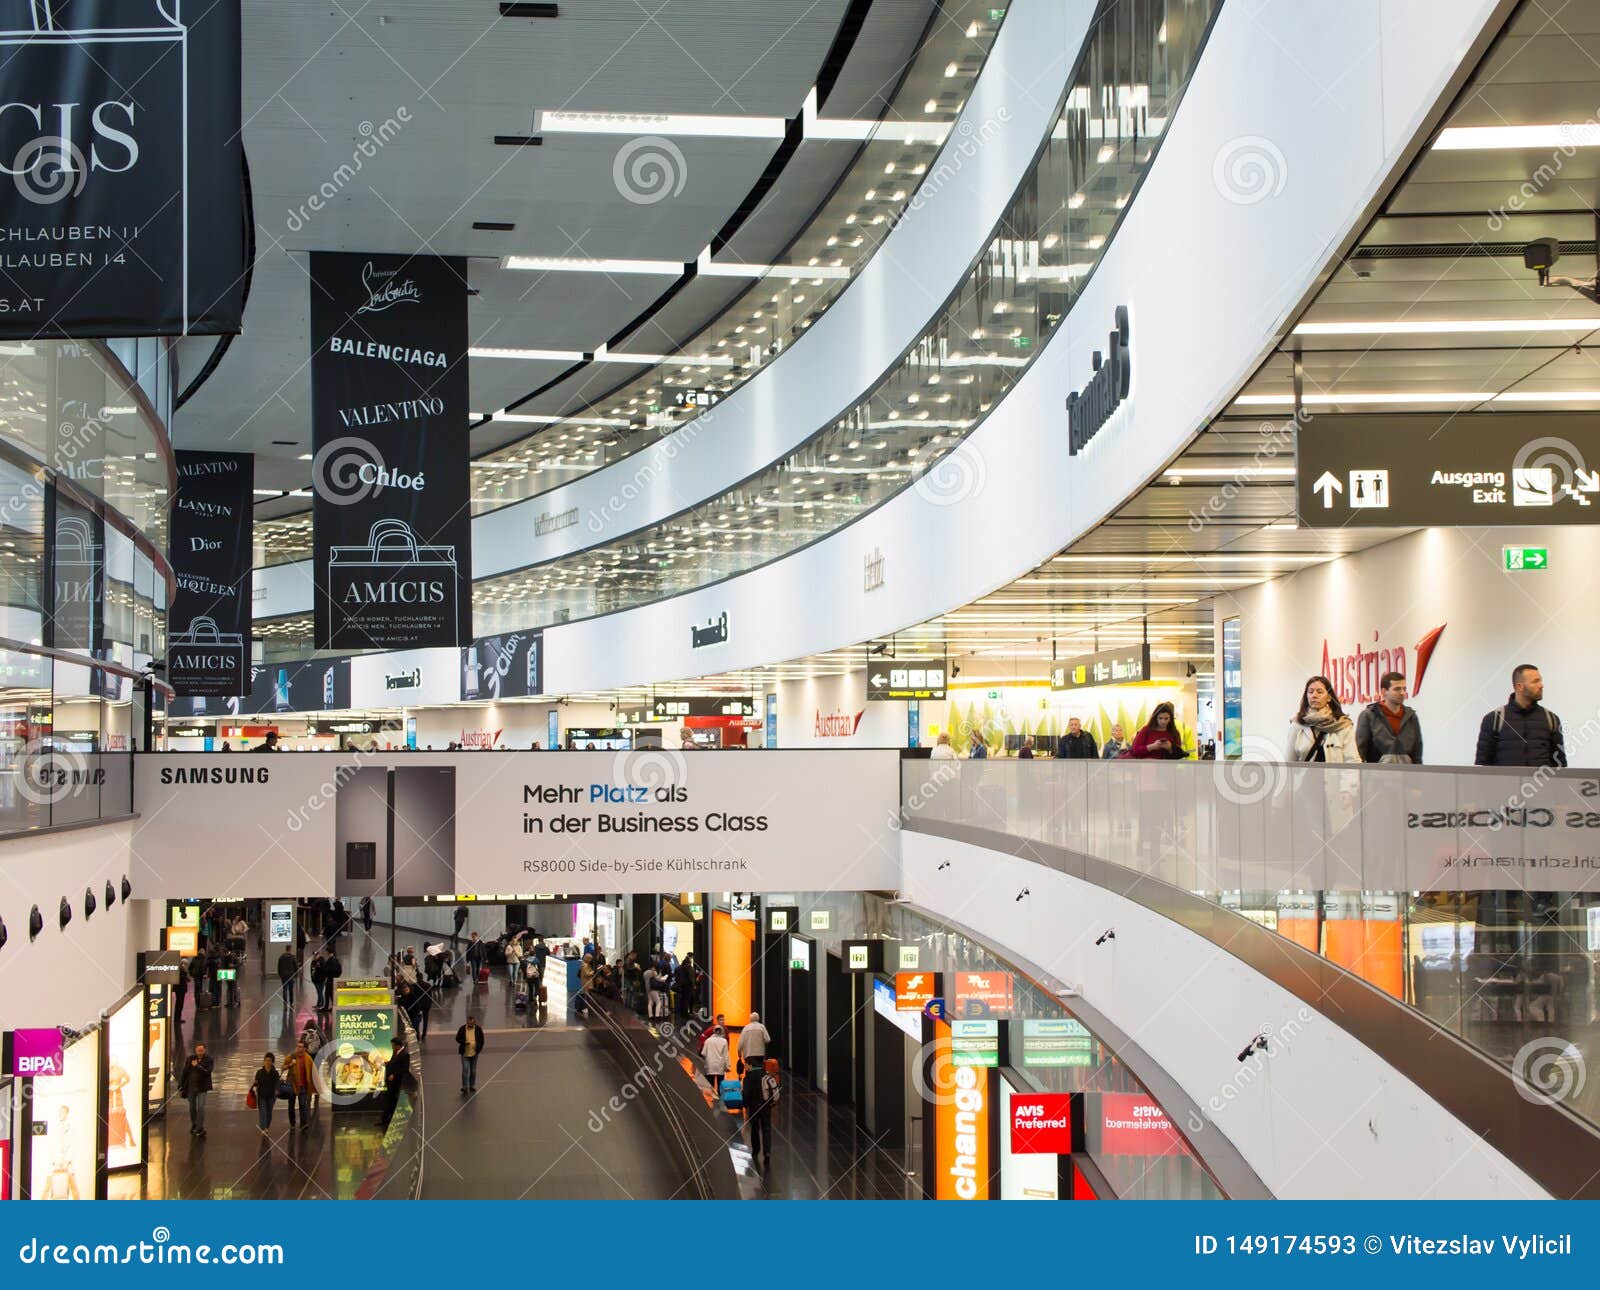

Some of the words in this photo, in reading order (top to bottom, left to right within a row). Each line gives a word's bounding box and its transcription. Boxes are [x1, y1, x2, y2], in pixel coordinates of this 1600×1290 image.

[0, 253, 92, 268] LAUBEN
[105, 253, 126, 266] 14
[330, 337, 448, 368] BALENCIAGA
[338, 397, 444, 427] VALENTINO
[358, 463, 425, 491] Chloé
[1431, 470, 1506, 487] Ausgang
[1473, 489, 1506, 503] Exit
[178, 498, 233, 516] LANVIN
[190, 536, 223, 551] Dior
[343, 582, 444, 603] AMICIS
[173, 655, 236, 669] AMICIS
[814, 707, 852, 738] Austrian
[461, 728, 492, 748] Austrian
[160, 767, 269, 784] SAMSUNG
[523, 784, 584, 803] Mehr
[590, 784, 649, 803] Platz
[654, 783, 689, 803] als
[523, 813, 543, 833] in
[549, 814, 592, 833] der
[598, 812, 699, 833] Business
[704, 812, 769, 832] Class
[523, 860, 576, 873] RS8000
[579, 859, 663, 874] Side-by-Side
[666, 858, 748, 871] Kühlschrank
[340, 1021, 378, 1029] PARKING
[18, 1056, 56, 1072] BIPA
[1015, 1105, 1045, 1117] AVIS
[1015, 1117, 1067, 1129] Preferred
[950, 1066, 982, 1199] change
